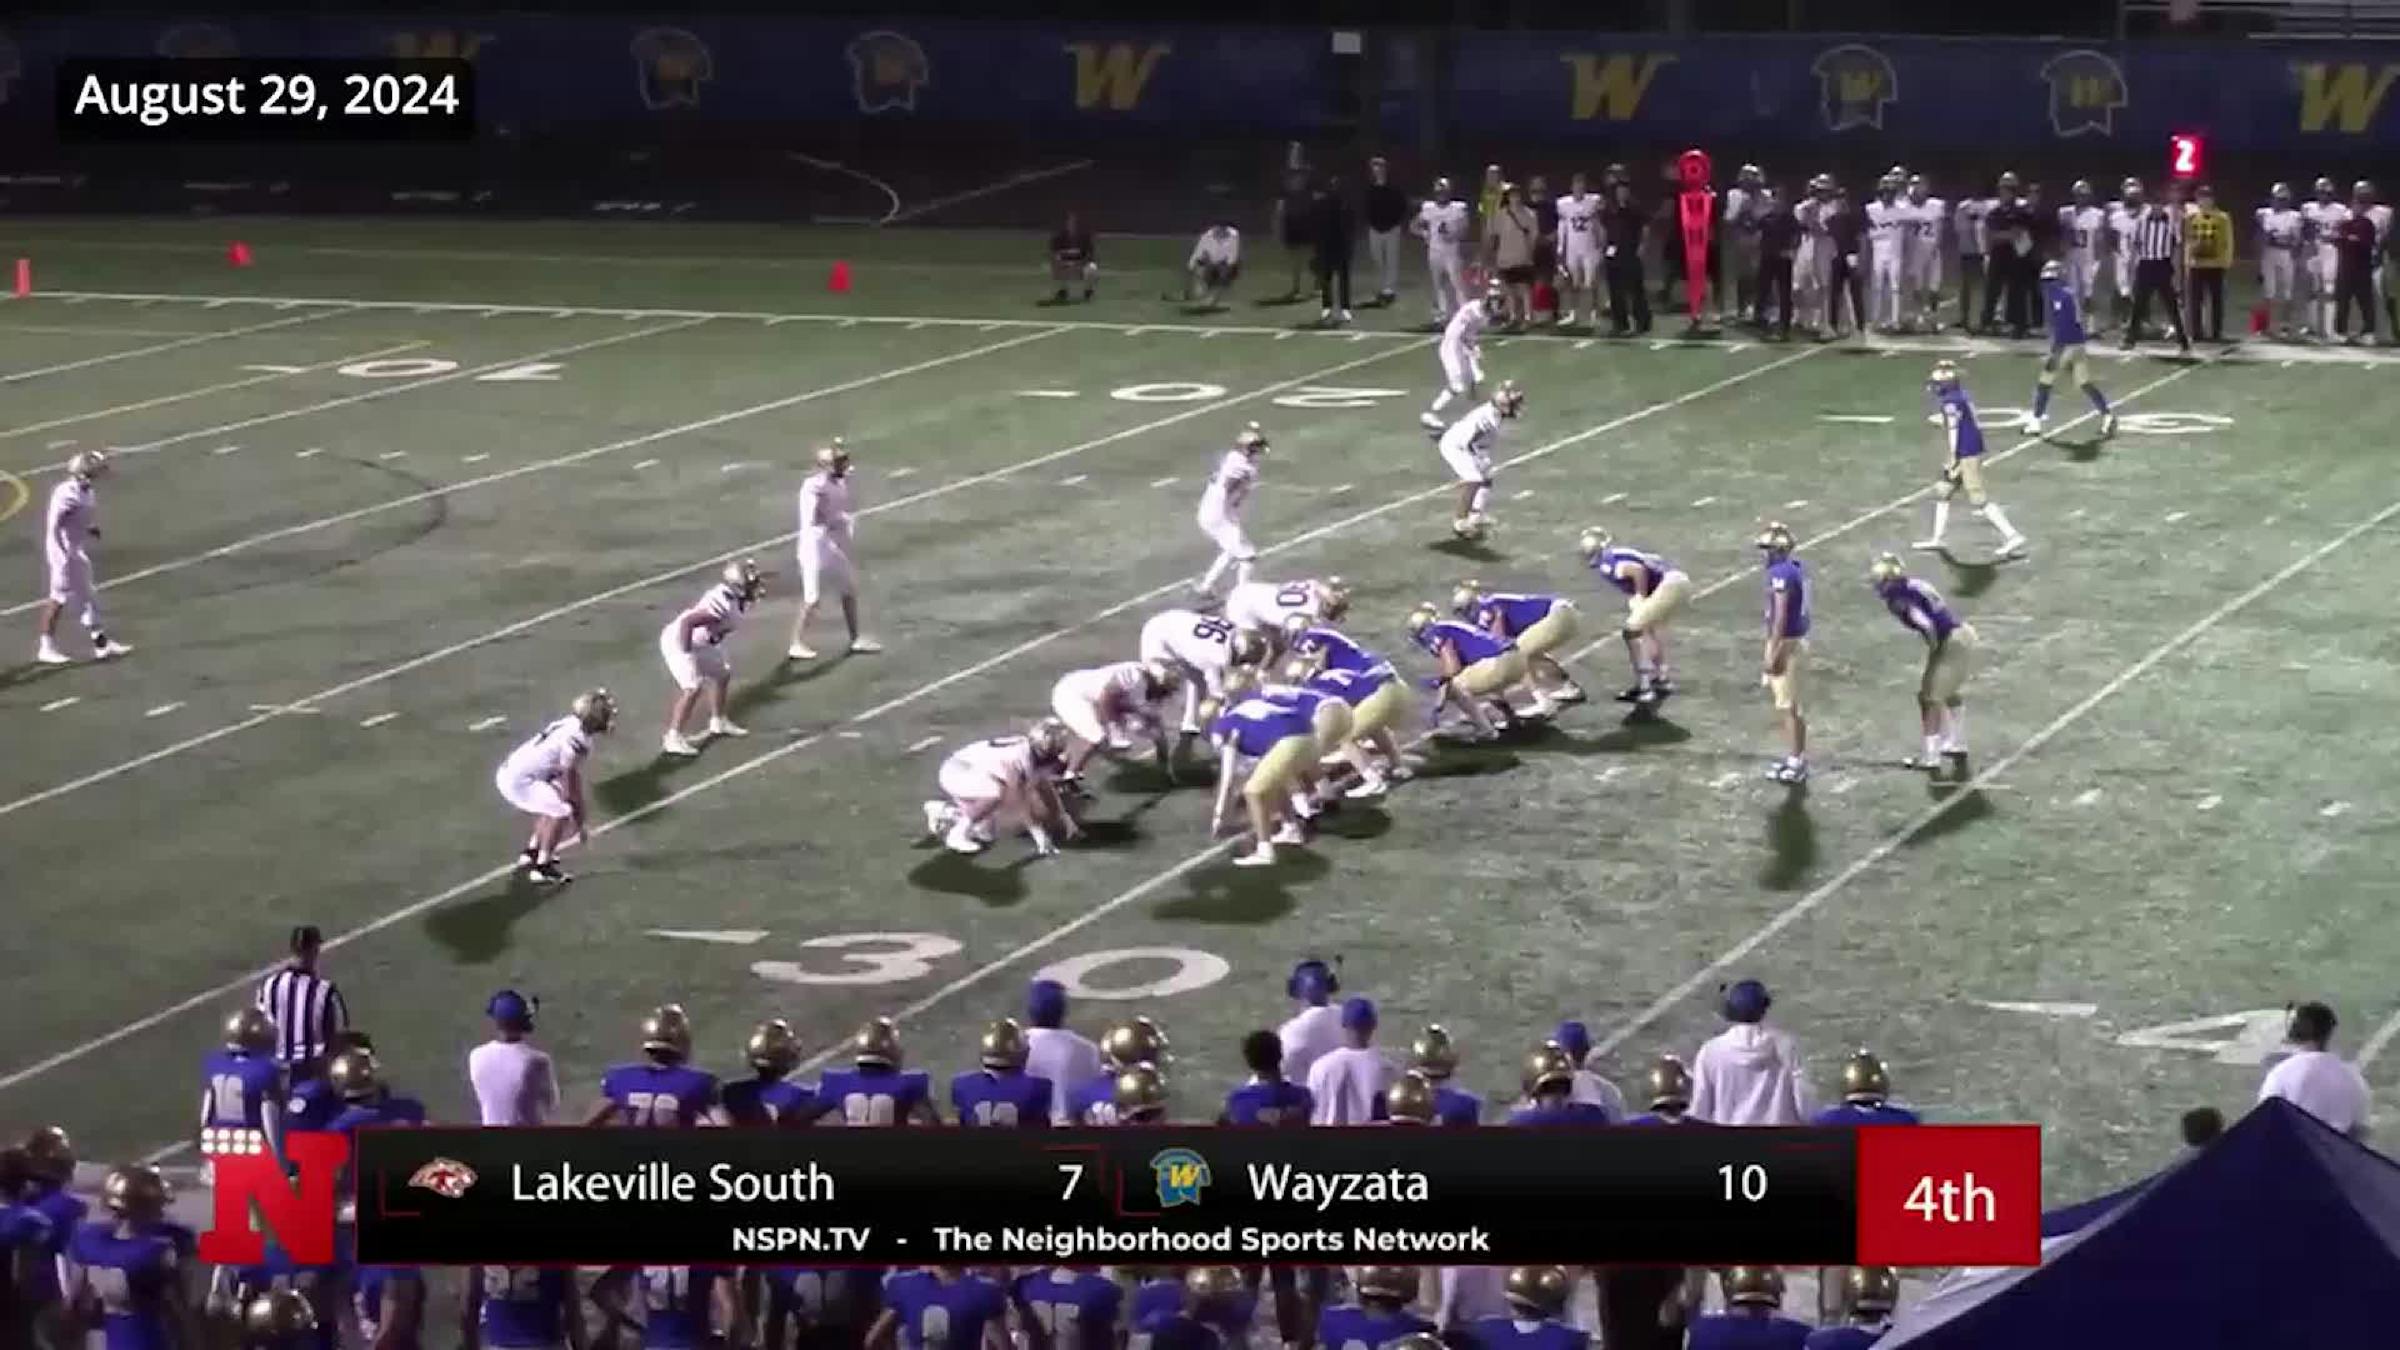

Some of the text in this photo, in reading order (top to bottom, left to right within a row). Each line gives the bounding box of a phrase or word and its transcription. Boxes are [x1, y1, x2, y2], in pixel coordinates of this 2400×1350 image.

[1065, 43, 1171, 110] W
[1561, 53, 1679, 121] W
[2288, 62, 2400, 134] W
[2173, 139, 2195, 171] 2
[750, 931, 1230, 1000] 30
